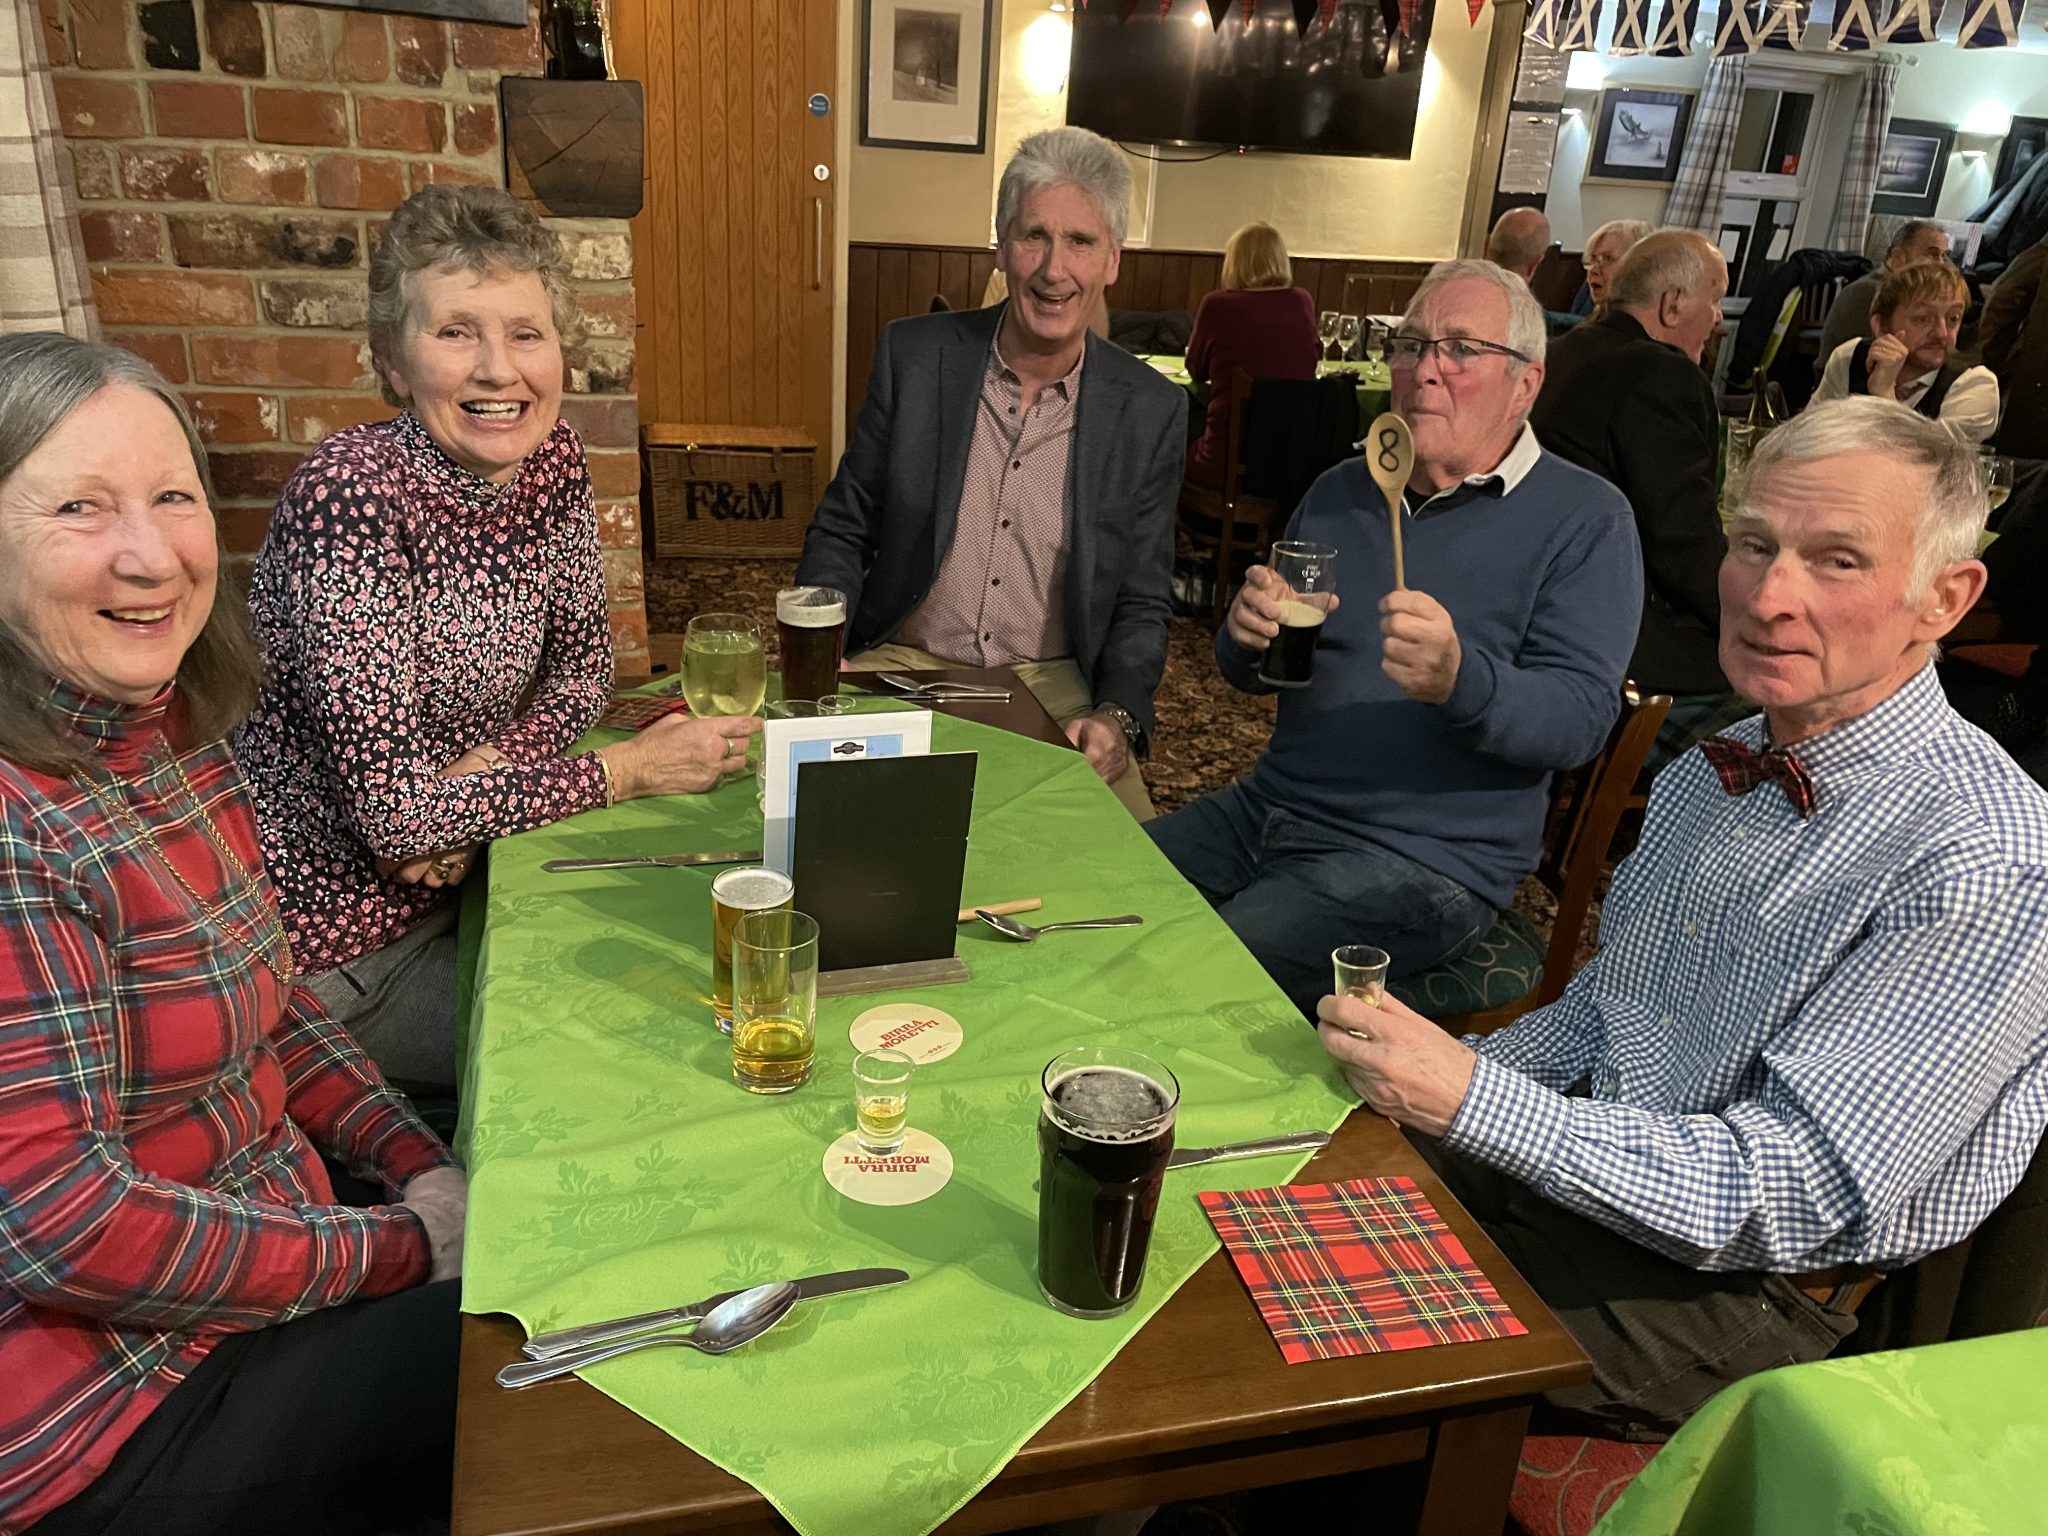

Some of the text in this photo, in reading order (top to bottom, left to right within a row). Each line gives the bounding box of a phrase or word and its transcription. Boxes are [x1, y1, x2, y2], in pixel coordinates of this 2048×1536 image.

[1379, 428, 1399, 472] 8
[684, 480, 784, 520] F&M
[879, 1020, 939, 1049] MORETTI
[880, 1020, 922, 1041] BIRRA
[844, 1156, 930, 1164] MORETTI
[859, 1164, 917, 1173] BIRRA
